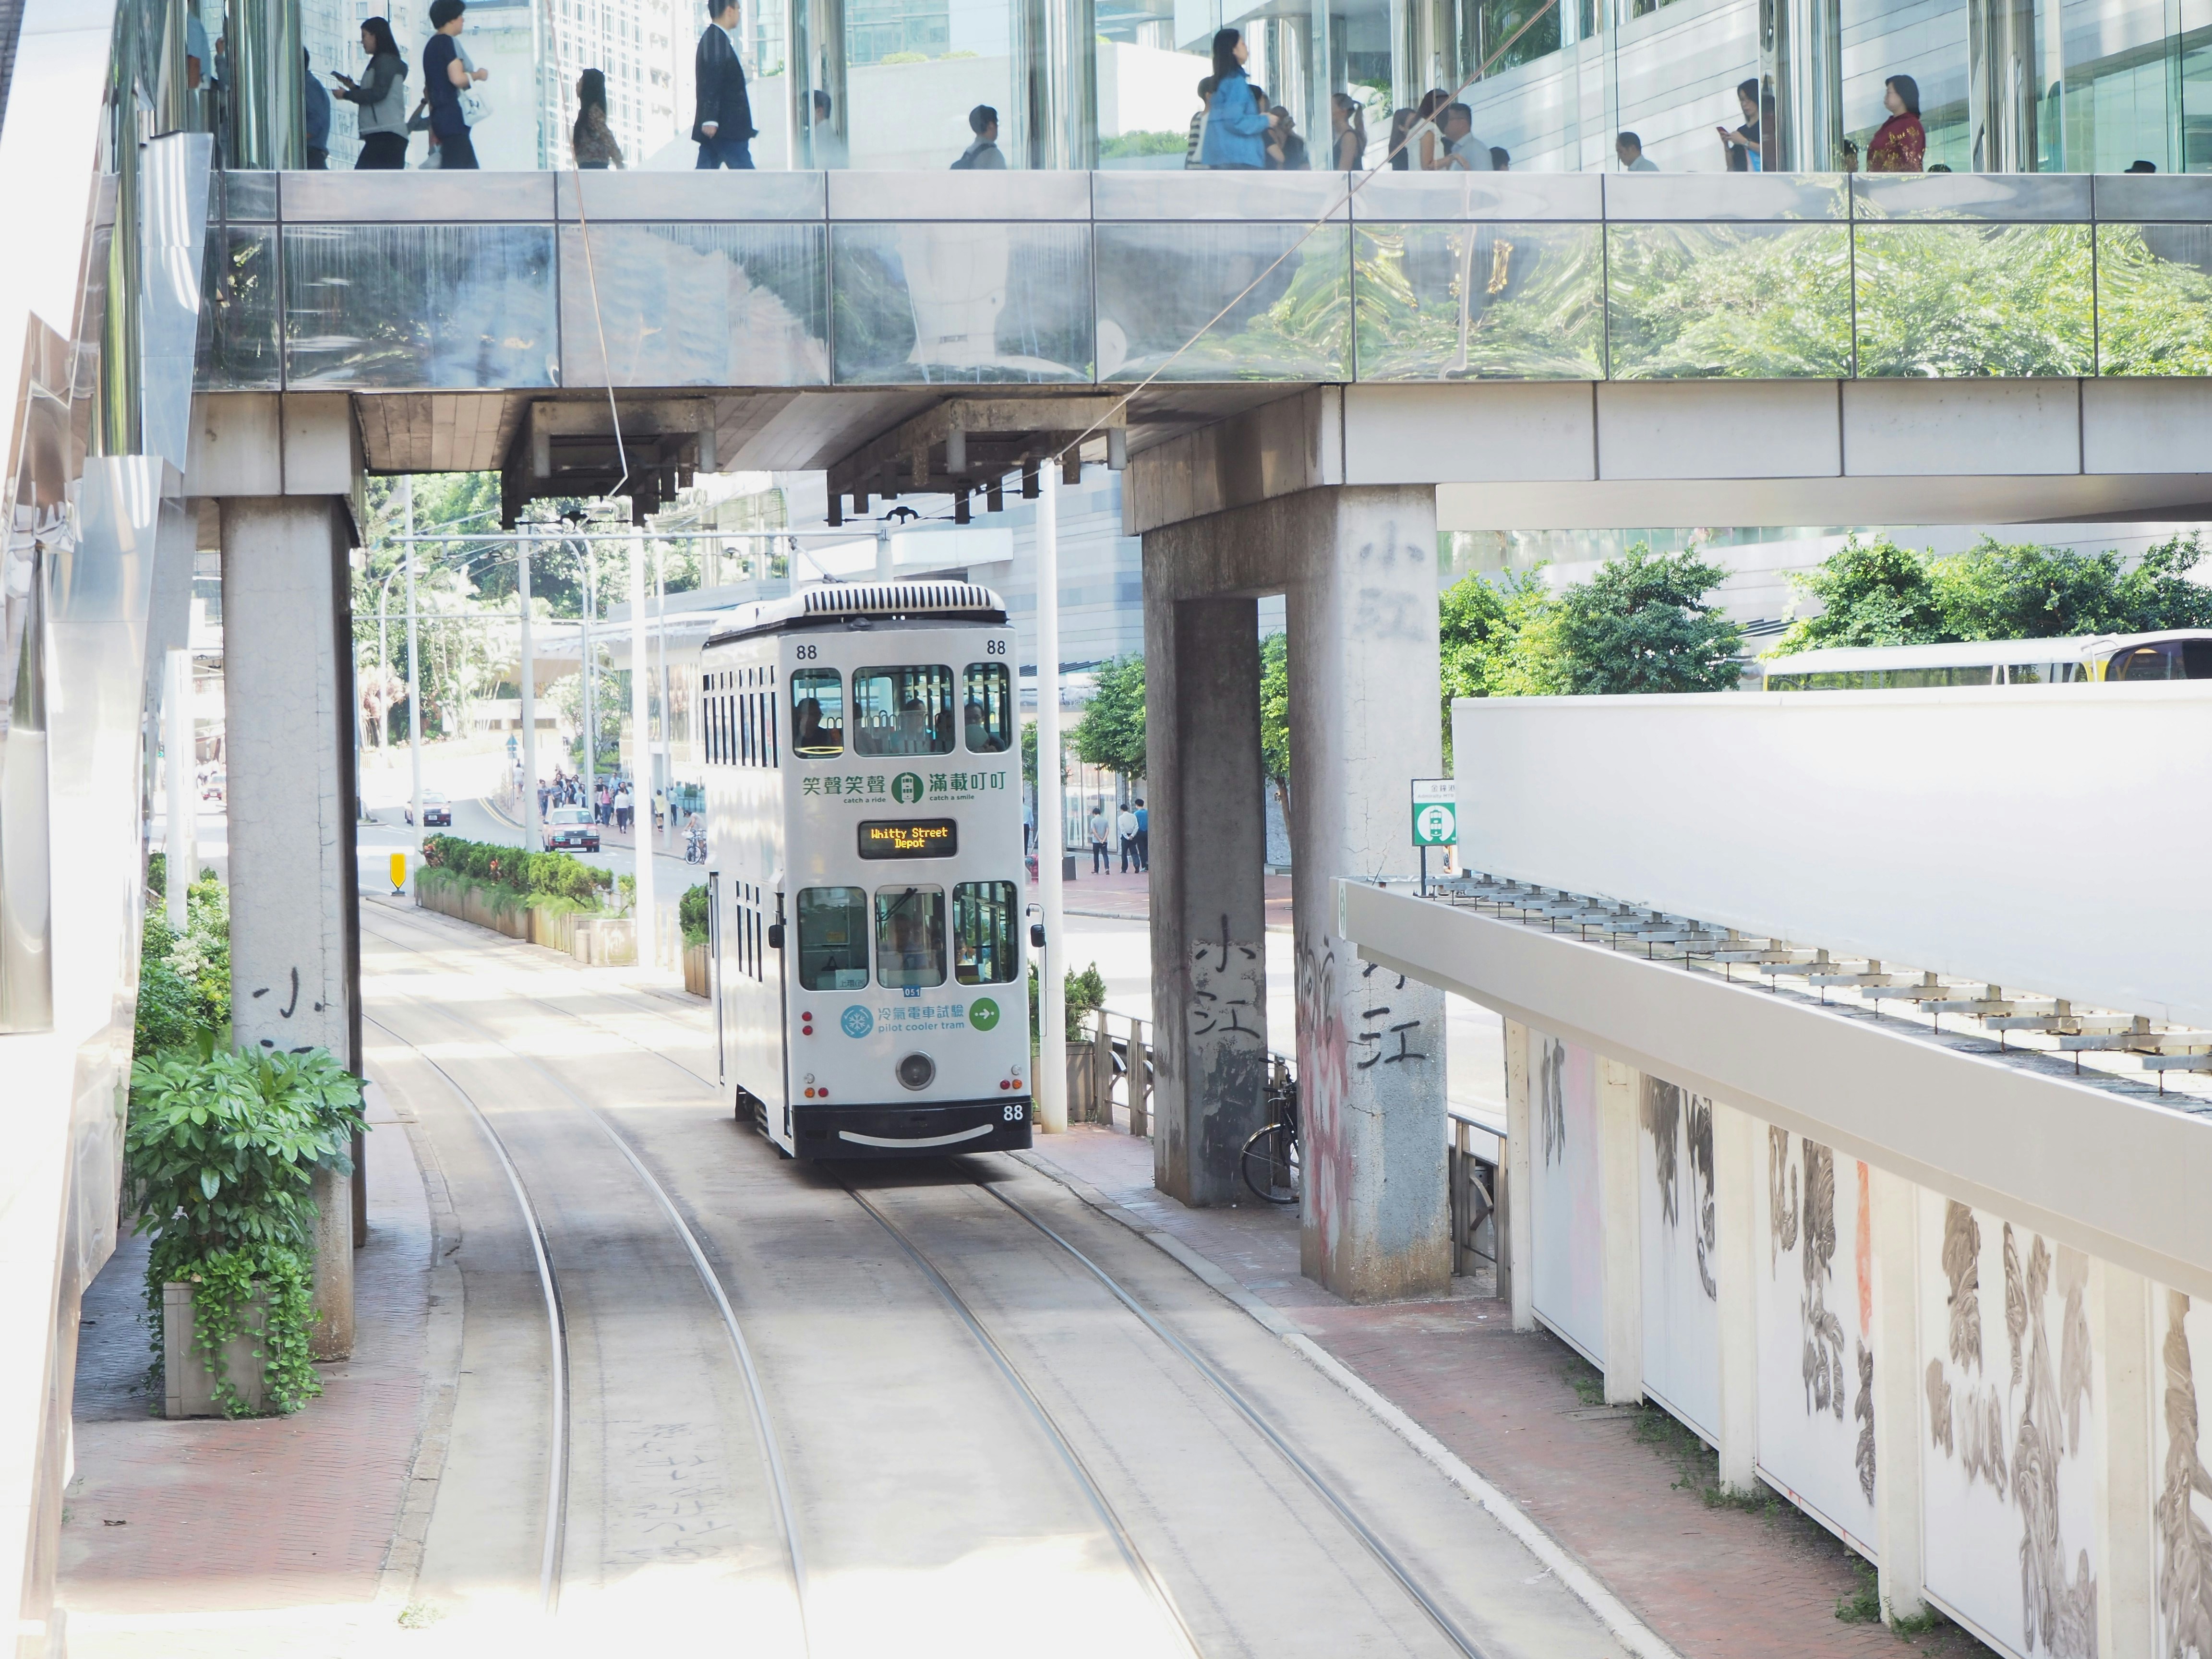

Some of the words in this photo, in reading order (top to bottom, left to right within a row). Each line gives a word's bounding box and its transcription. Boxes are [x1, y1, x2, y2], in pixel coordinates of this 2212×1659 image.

[797, 645, 817, 660] 88
[987, 640, 1006, 655] 88
[803, 775, 886, 795] 笑聲笑聲
[929, 771, 1006, 792] 滿載叮叮
[871, 829, 907, 839] Whitty
[912, 827, 948, 838] Street
[895, 838, 925, 849] Depot
[878, 1004, 964, 1021] 冷氣電車試驗
[878, 1023, 902, 1033] pilot
[906, 1022, 938, 1031] cooler
[1004, 1105, 1023, 1121] 88
